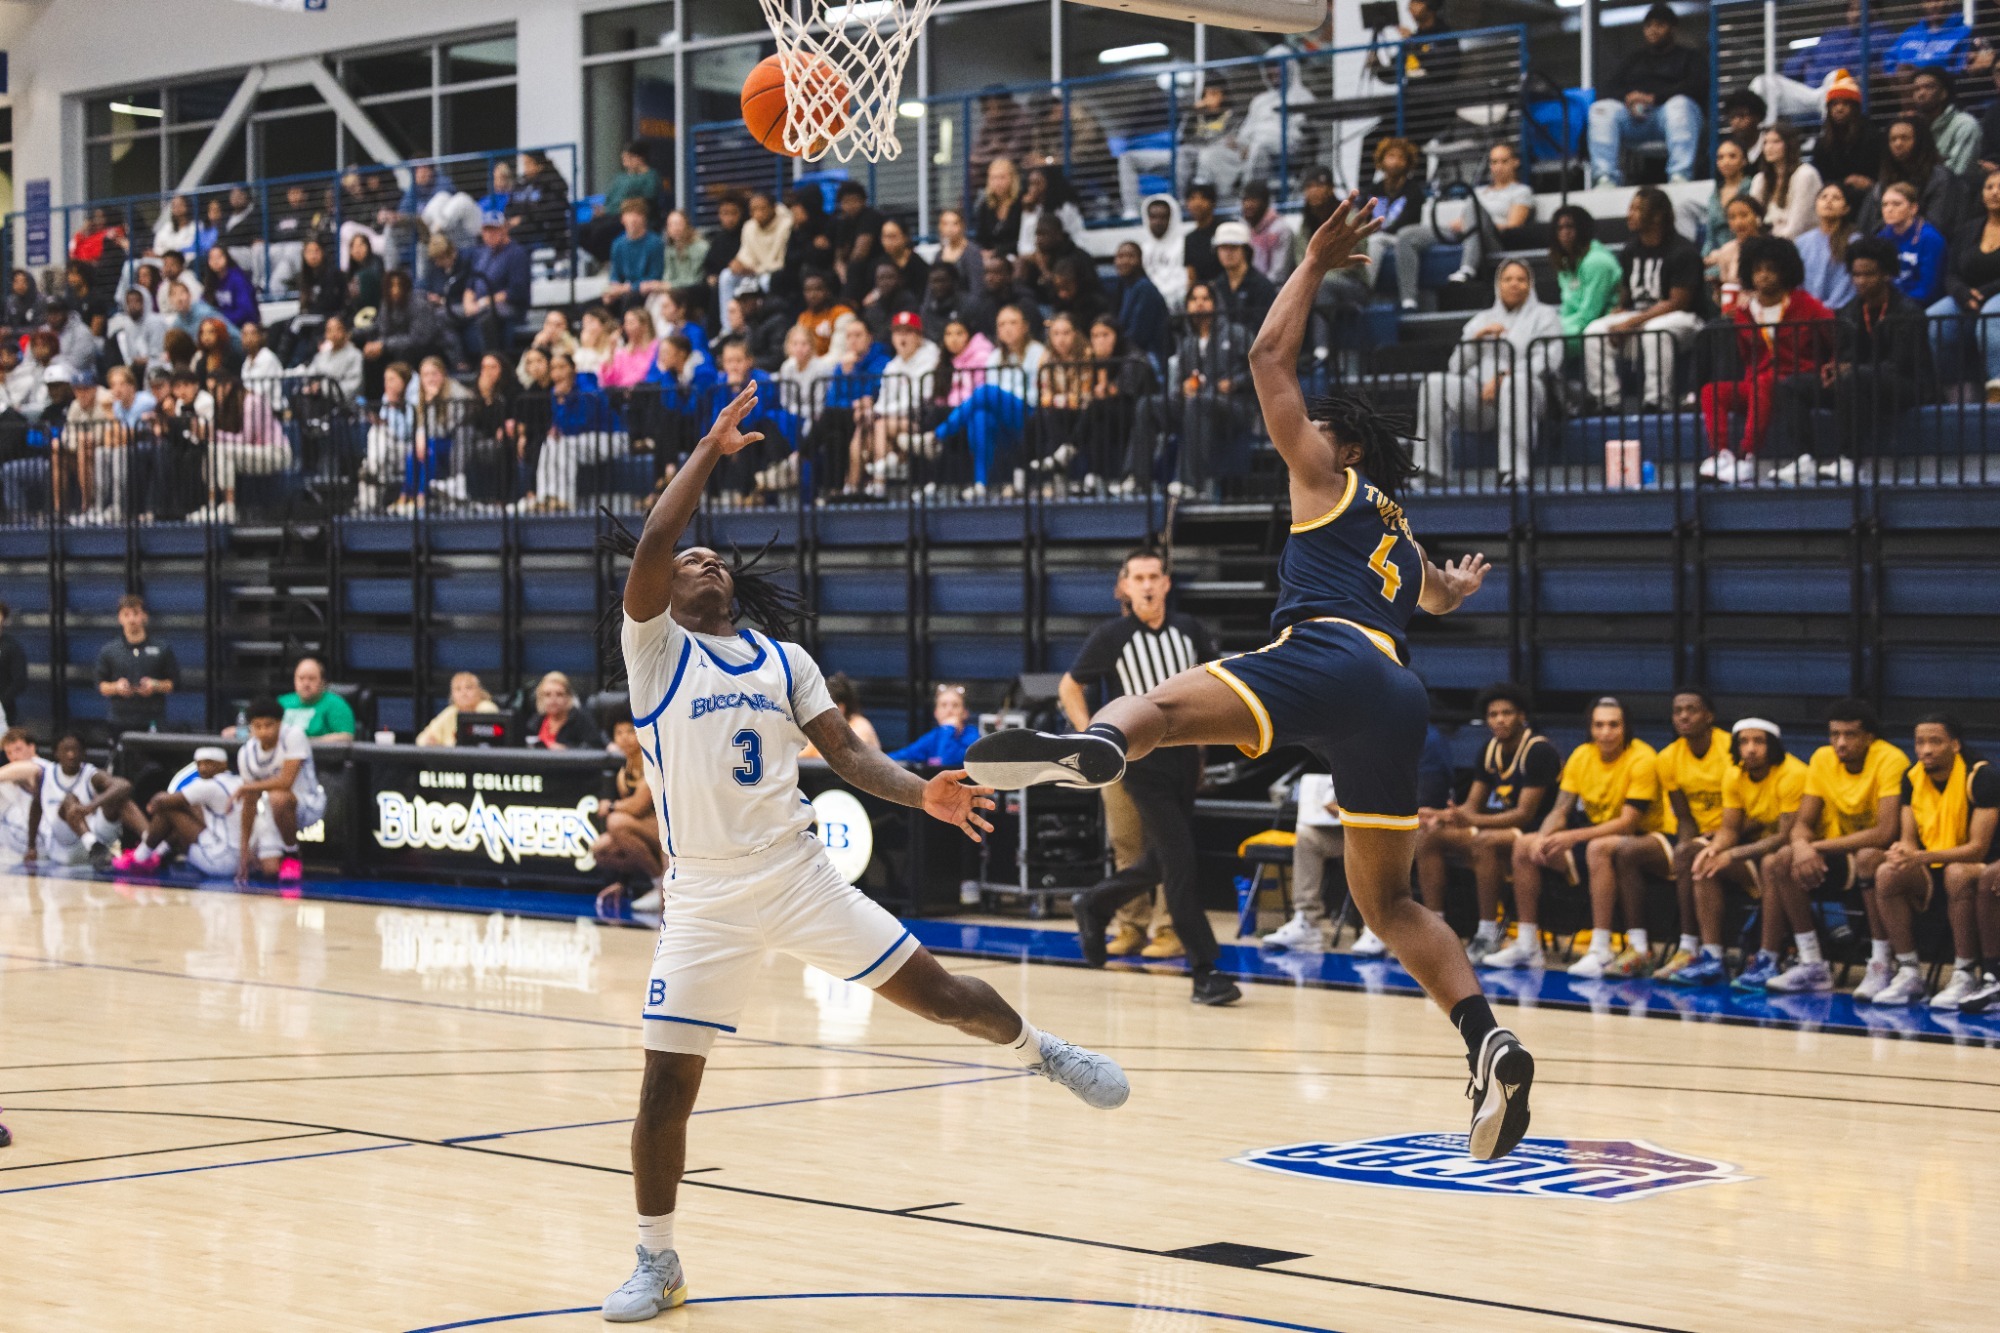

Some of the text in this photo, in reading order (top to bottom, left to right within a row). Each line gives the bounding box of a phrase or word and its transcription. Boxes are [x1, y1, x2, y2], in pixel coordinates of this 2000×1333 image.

[1368, 533, 1402, 603] 4
[732, 729, 763, 787] 3
[419, 770, 543, 793] BLINN COLLEGE
[372, 790, 599, 872] BUCCANEERS
[825, 822, 849, 848] B
[648, 979, 667, 1006] B
